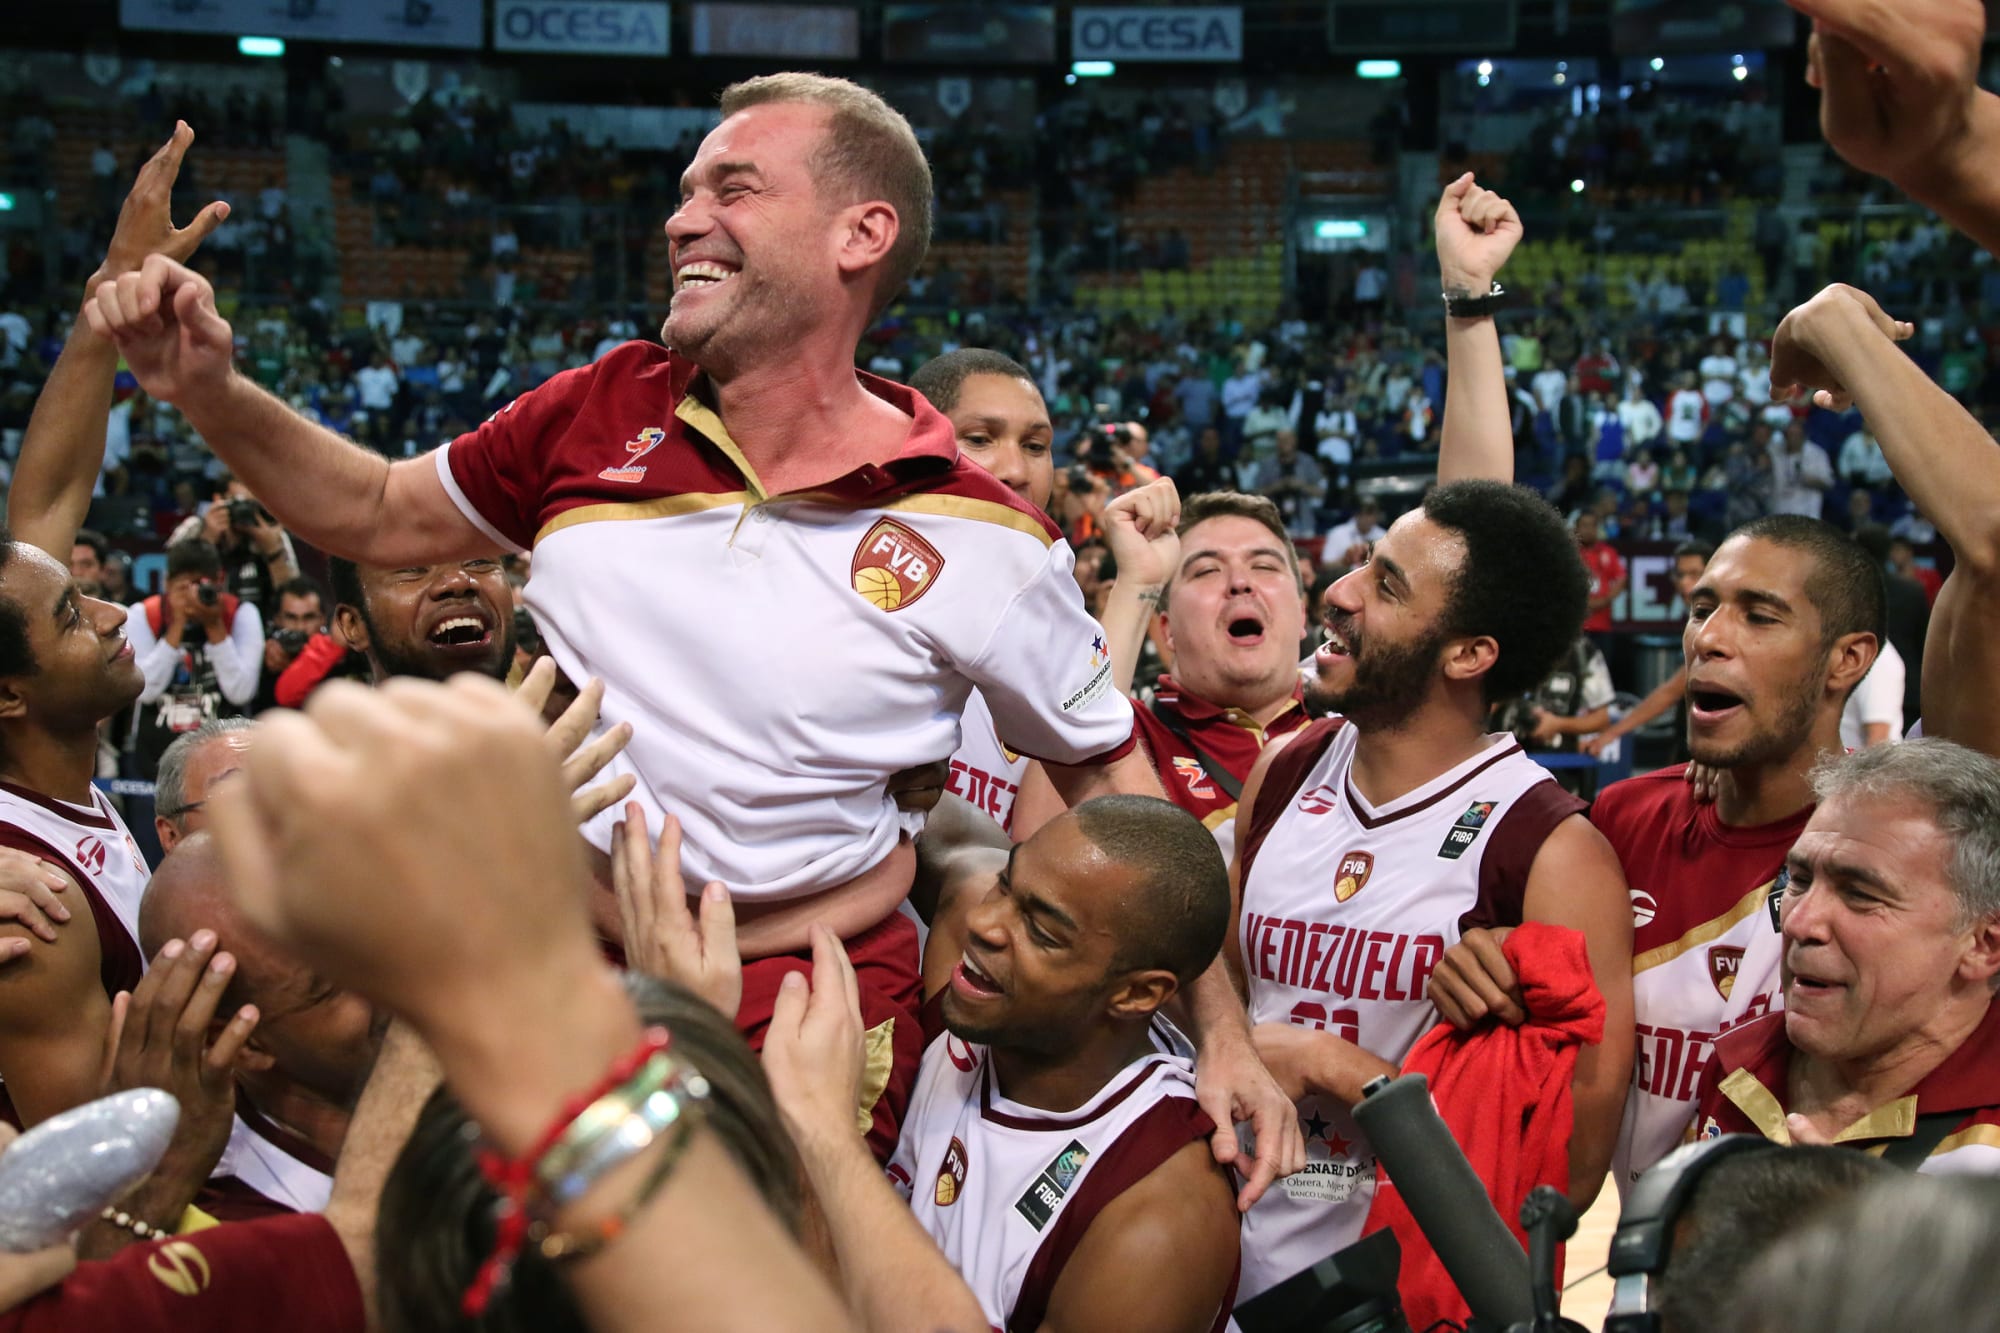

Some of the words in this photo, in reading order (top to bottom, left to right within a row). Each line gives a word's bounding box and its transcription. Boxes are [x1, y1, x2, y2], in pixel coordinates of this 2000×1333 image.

[504, 6, 657, 44] OCESA
[1080, 17, 1232, 50] OCESA
[872, 534, 928, 582] FVB
[1063, 690, 1083, 711] BANCO
[1450, 830, 1473, 844] FIBA
[1342, 860, 1366, 874] FVB
[1247, 912, 1444, 1001] VENEZUELA
[1715, 956, 1745, 972] FV
[947, 1149, 964, 1182] FVB
[1034, 1182, 1062, 1212] FIBA
[1287, 1177, 1324, 1189] Obrera,
